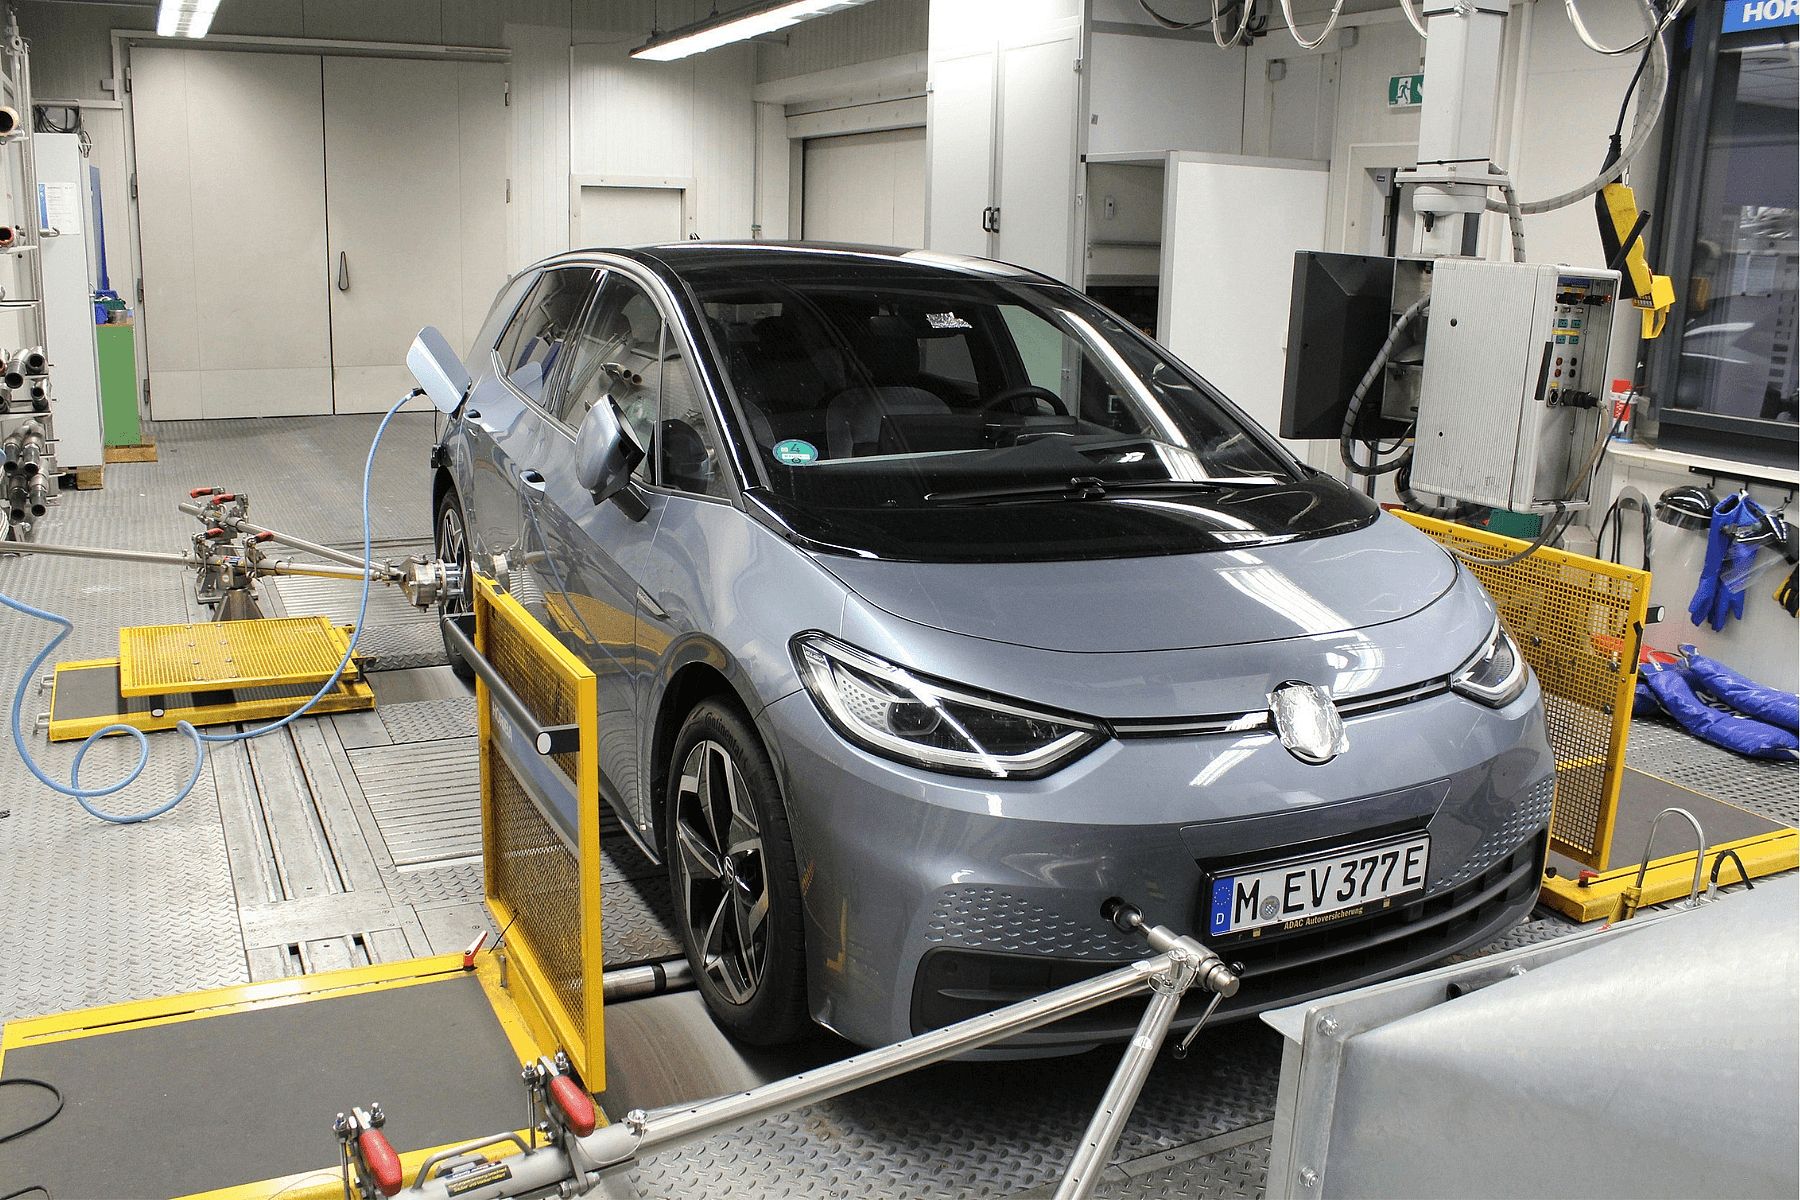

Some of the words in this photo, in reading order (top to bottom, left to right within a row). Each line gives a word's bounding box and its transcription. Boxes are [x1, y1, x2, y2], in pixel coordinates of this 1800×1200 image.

[1743, 0, 1799, 22] HOR
[1234, 879, 1260, 924] M
[1282, 865, 1332, 914] EV
[1216, 913, 1225, 925] D
[1283, 918, 1304, 930] ADAC
[1304, 906, 1364, 927] Autoversicherung
